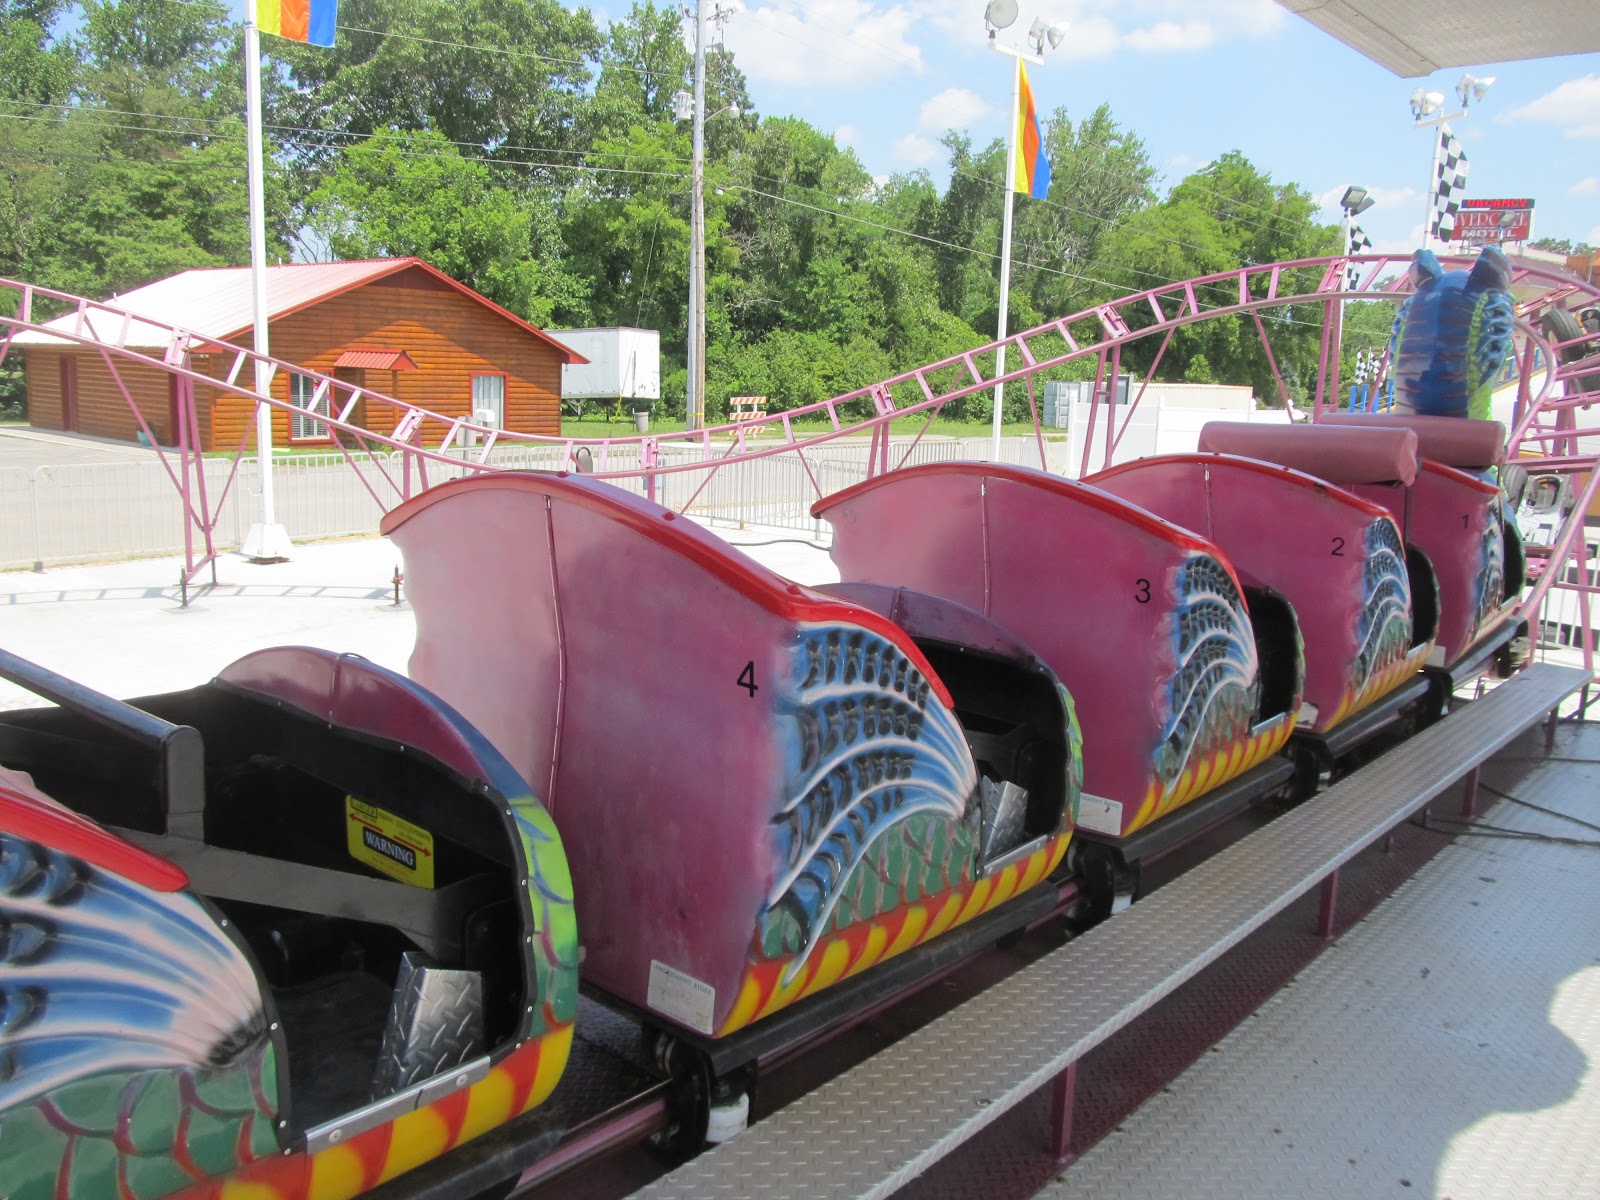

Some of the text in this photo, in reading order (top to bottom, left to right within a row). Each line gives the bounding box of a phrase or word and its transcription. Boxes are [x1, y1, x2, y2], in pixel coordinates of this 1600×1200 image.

[1467, 199, 1527, 207] VACANCY
[1461, 514, 1469, 528] 1
[1331, 537, 1345, 556] 2
[1135, 578, 1151, 604] 3
[737, 660, 759, 698] 4
[365, 830, 414, 866] WARNING
[693, 982, 712, 996] RIDES
